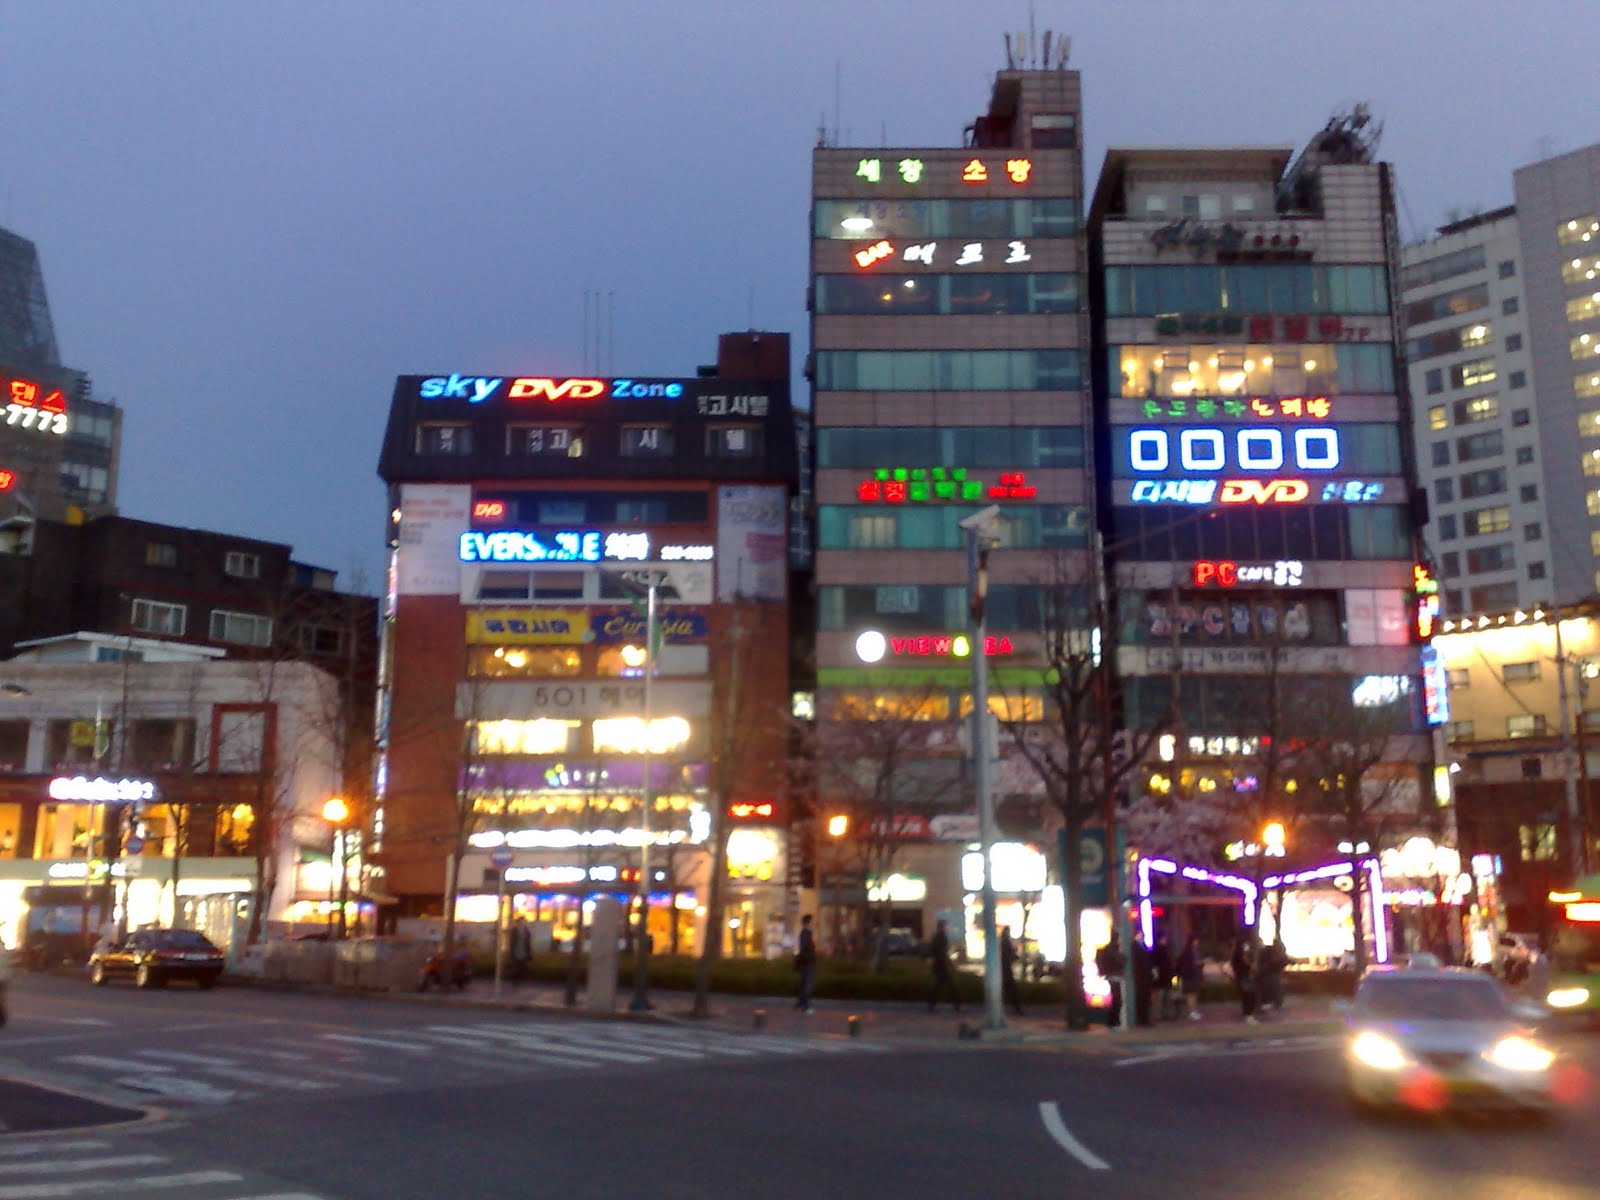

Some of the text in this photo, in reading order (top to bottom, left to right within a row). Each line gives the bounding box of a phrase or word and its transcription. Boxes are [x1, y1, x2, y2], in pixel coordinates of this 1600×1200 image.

[962, 158, 1032, 183] 소방
[9, 379, 66, 414] 댄스
[418, 373, 684, 403] sky DVD Zone
[1219, 478, 1312, 505] DVD
[472, 500, 505, 520] DVD
[1194, 561, 1237, 587] PC
[602, 616, 695, 636] Eursia
